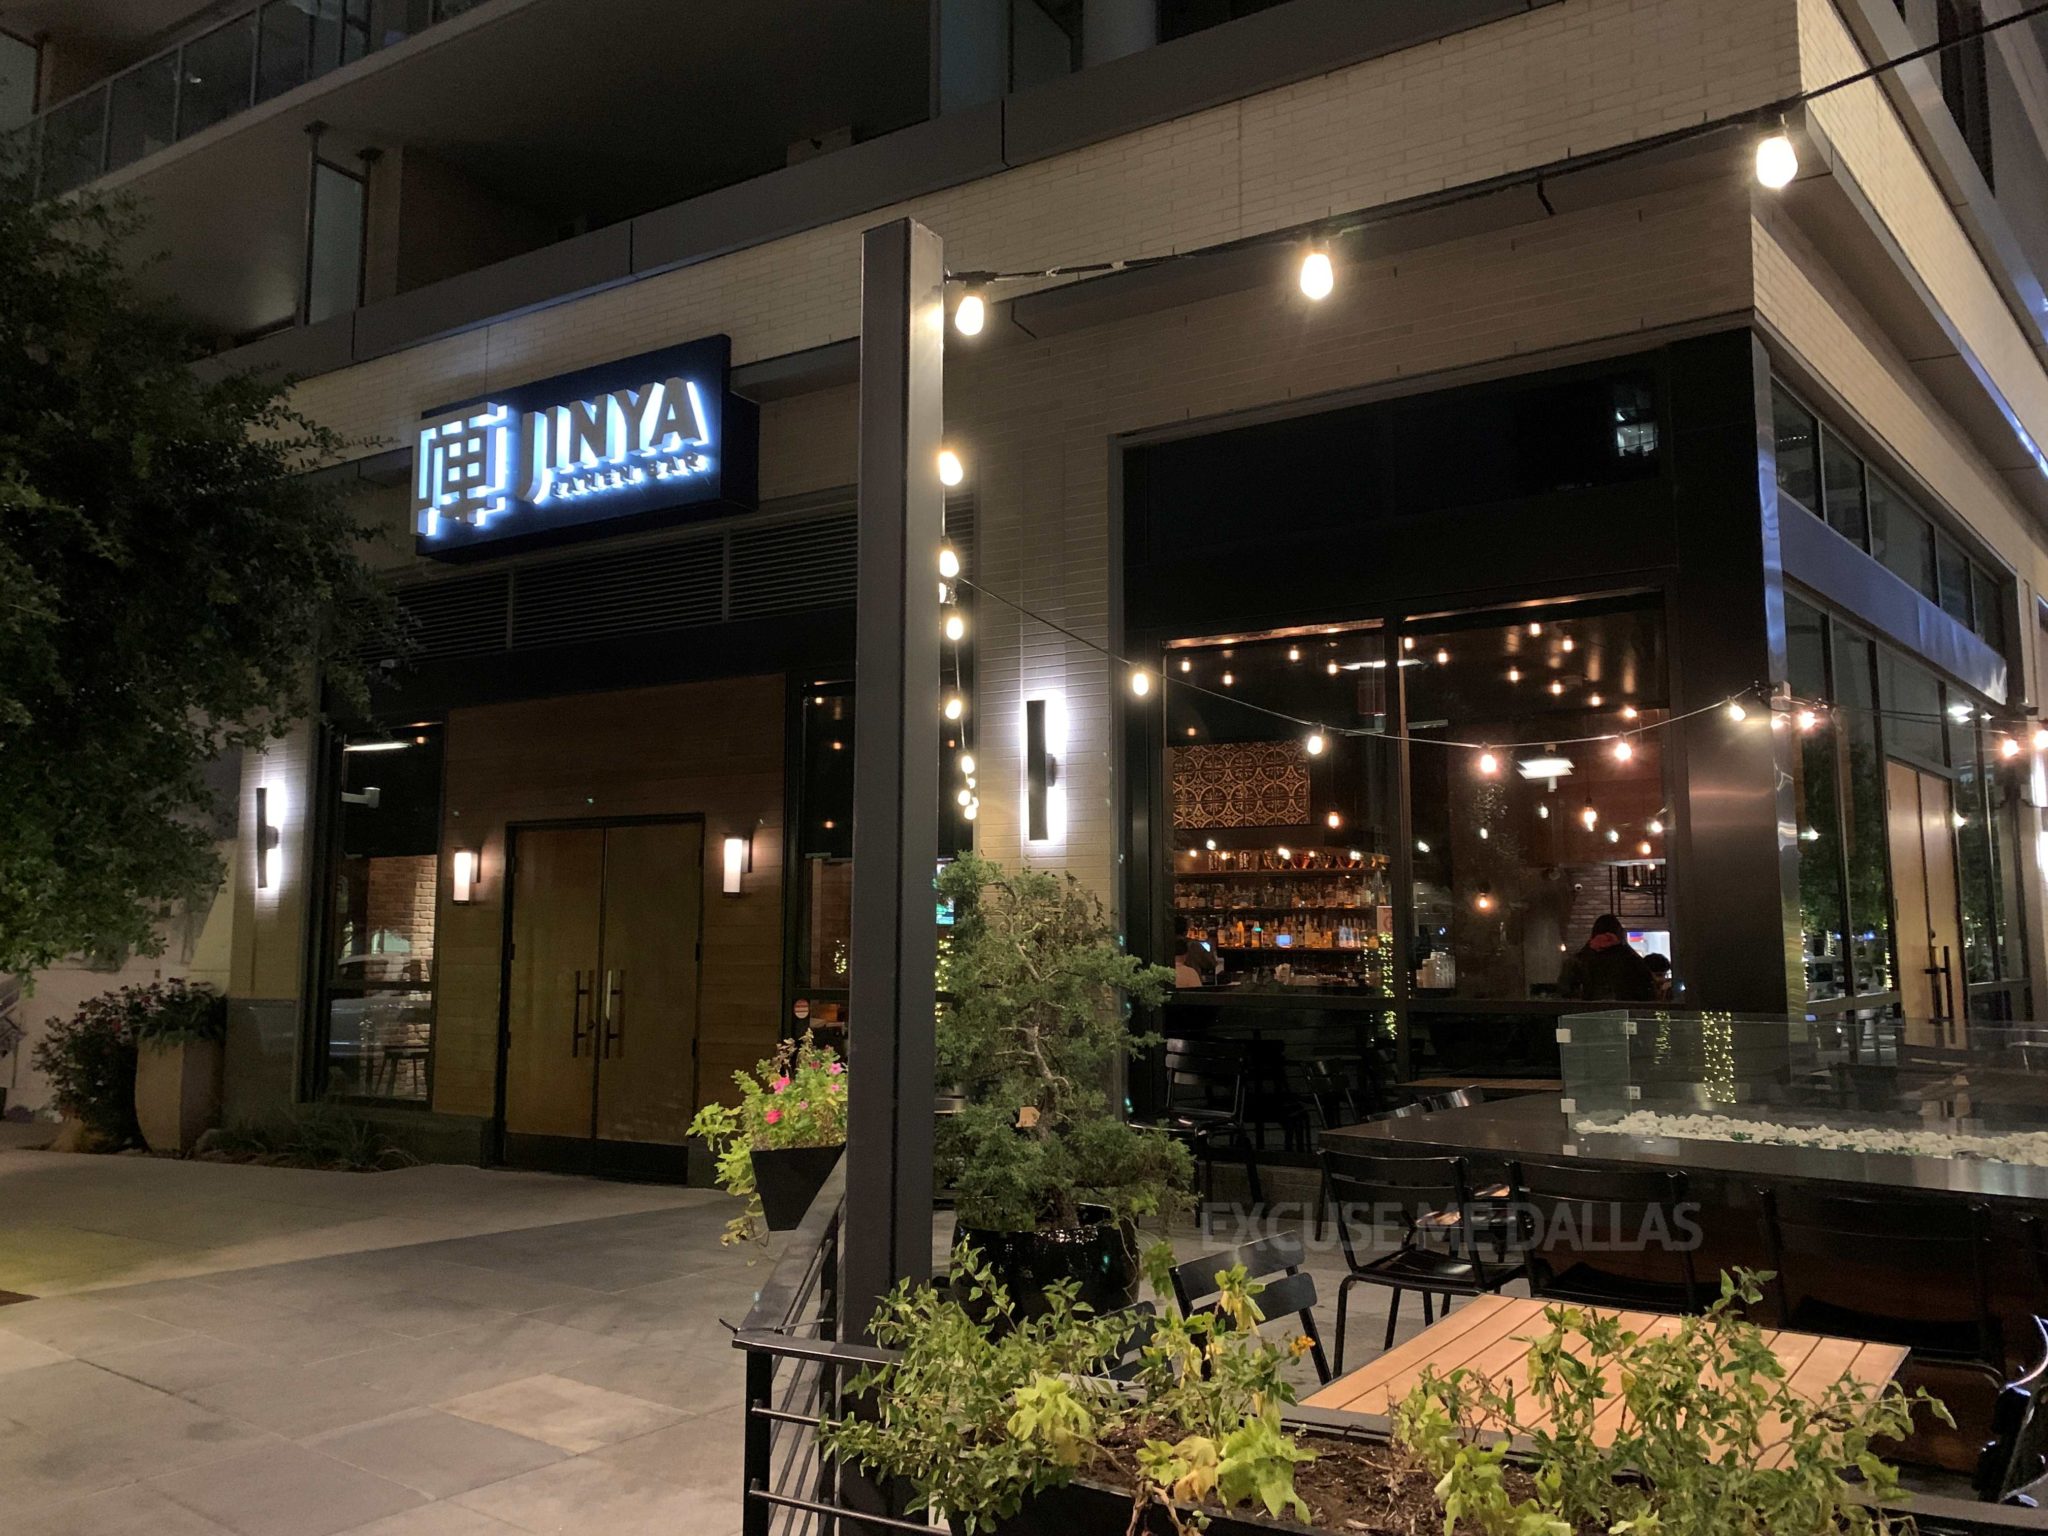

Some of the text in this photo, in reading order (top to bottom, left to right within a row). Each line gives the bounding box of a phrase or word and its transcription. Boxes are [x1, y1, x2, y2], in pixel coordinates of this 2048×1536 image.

[517, 377, 709, 504] JINYA
[549, 451, 709, 500] RAMEN BAR
